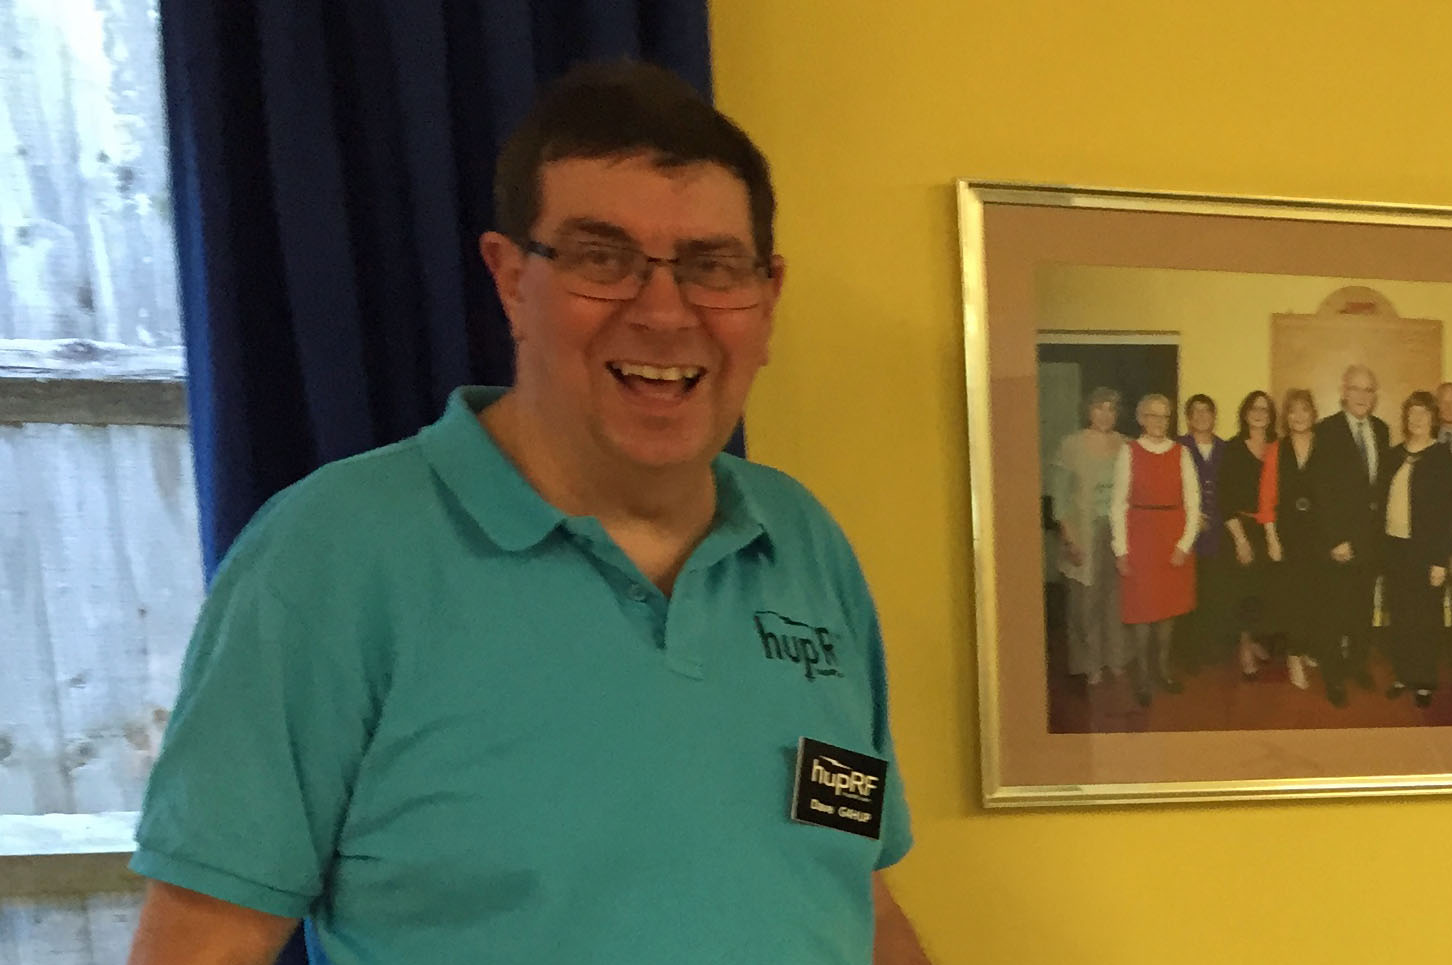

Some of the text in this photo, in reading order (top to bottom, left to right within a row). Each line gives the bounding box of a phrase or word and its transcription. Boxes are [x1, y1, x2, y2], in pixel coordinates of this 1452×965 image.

[810, 757, 879, 797] hupRF
[810, 799, 872, 823] Dave G4HUP
